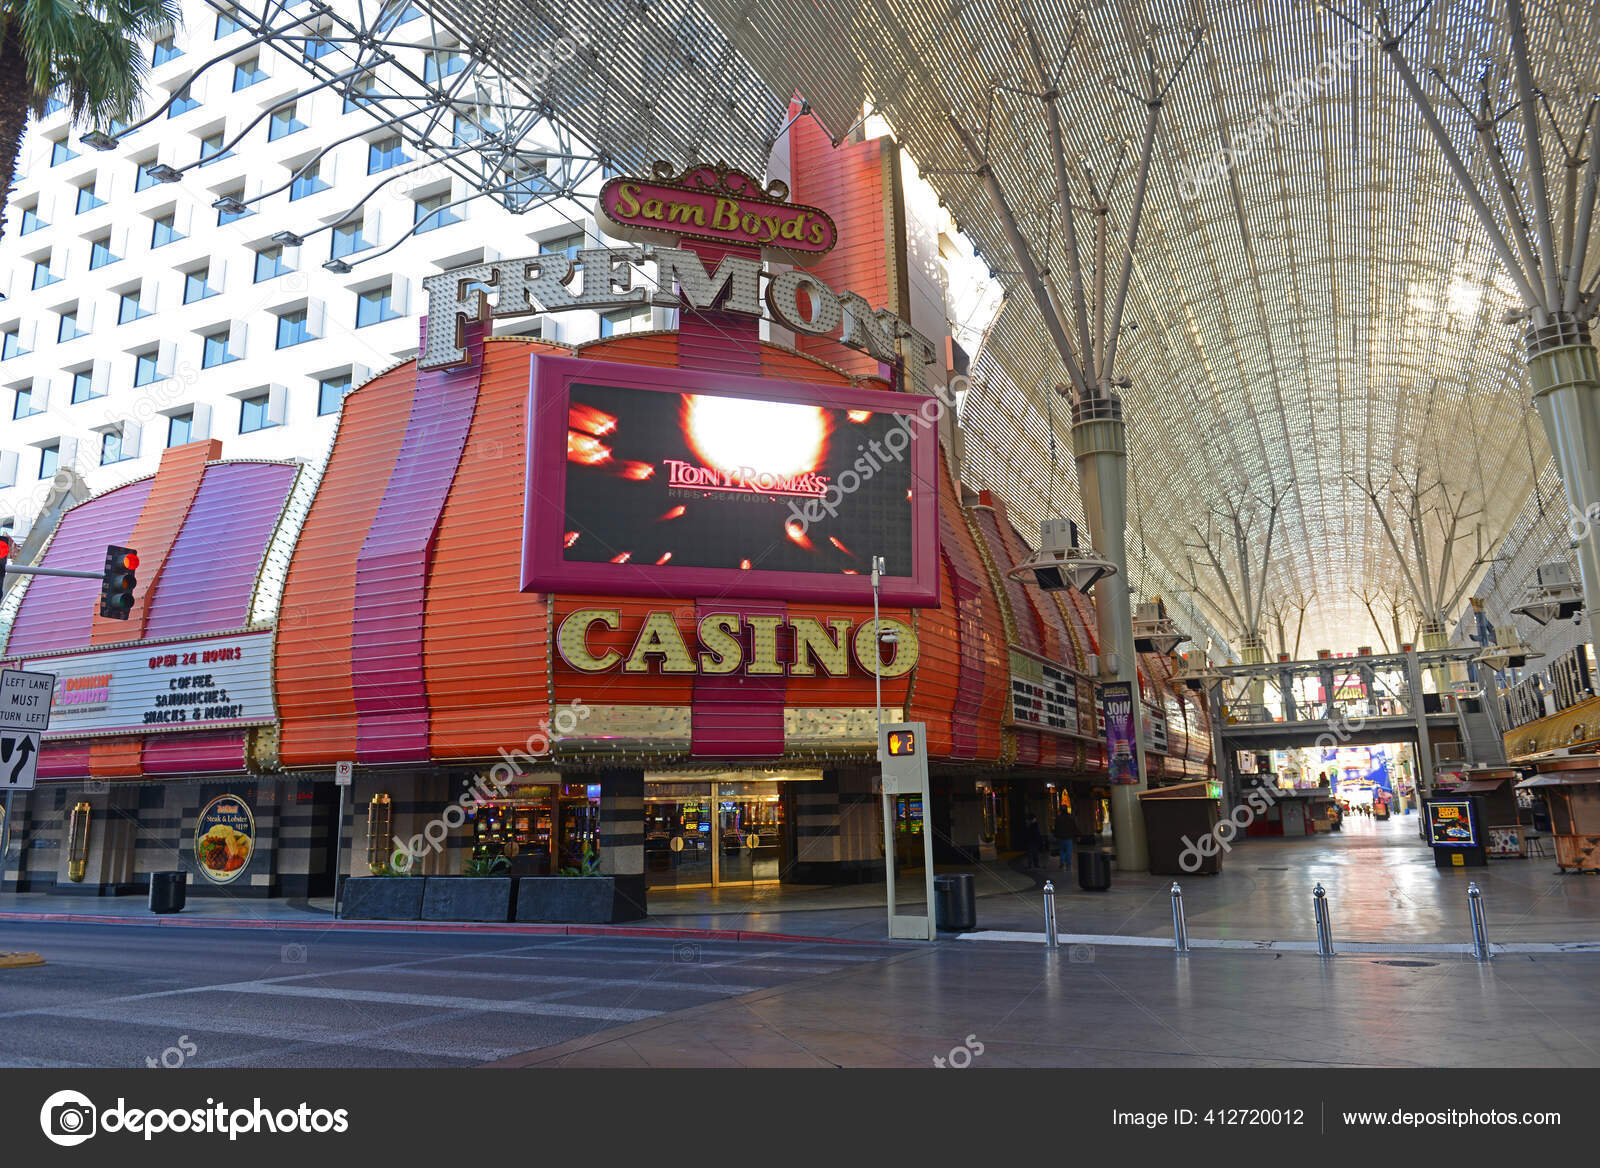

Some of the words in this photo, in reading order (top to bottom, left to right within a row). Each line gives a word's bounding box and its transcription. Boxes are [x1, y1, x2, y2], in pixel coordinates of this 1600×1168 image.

[614, 182, 706, 227] Sam
[711, 197, 825, 245] Boyd's
[417, 247, 936, 394] FREMONT
[557, 607, 920, 679] CASINO
[149, 654, 177, 669] OPEN
[182, 652, 197, 666] 24
[202, 646, 241, 663] HOURS
[6, 677, 25, 688] LEFT
[29, 680, 49, 690] LANE
[11, 694, 39, 706] MUST
[64, 688, 109, 704] DONUTS
[143, 709, 186, 724] SNACKS
[193, 707, 201, 720] &
[204, 704, 242, 719] MORE!
[1107, 701, 1131, 715] JOIN
[0, 711, 21, 721] TURN
[26, 713, 46, 723] LEFT
[1110, 714, 1129, 725] THE
